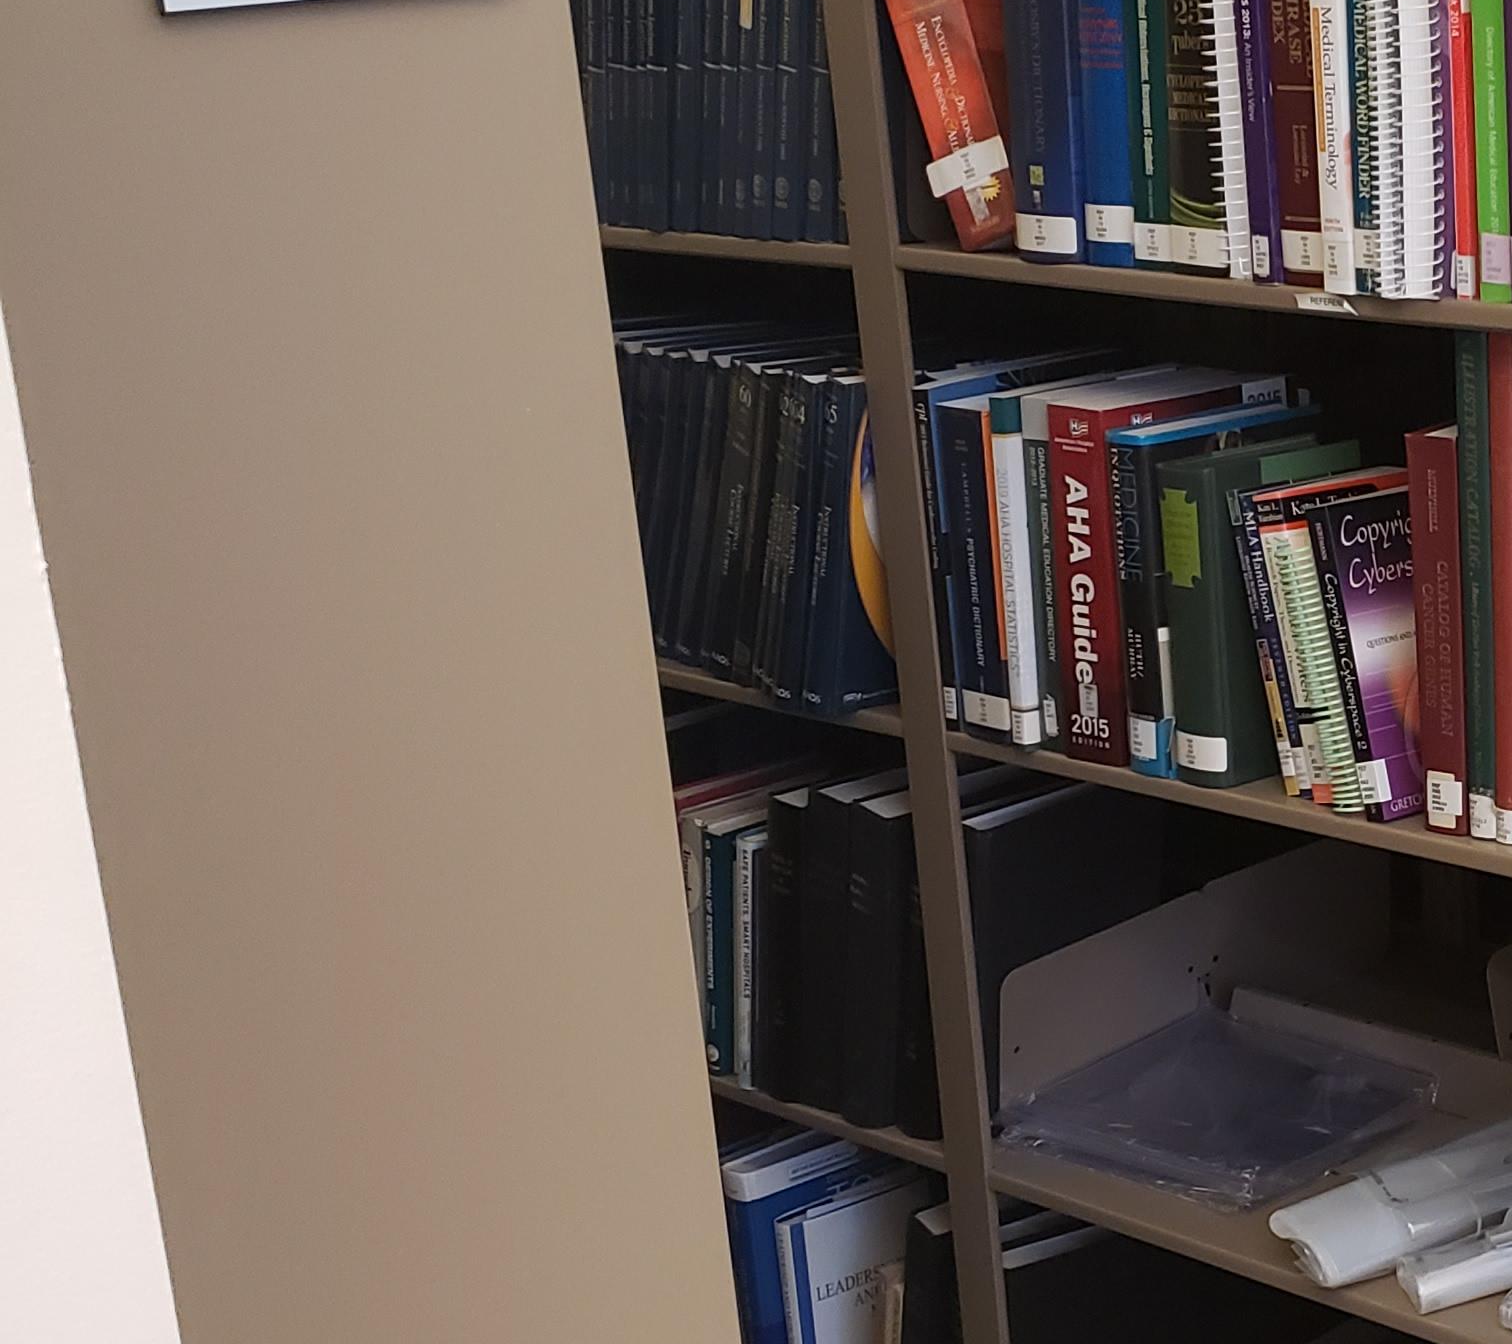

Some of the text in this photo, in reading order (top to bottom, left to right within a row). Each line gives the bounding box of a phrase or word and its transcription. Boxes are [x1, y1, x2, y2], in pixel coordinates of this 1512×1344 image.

[931, 15, 958, 84] ENCYCLOPEDIA
[1450, 10, 1460, 37] 2014
[1033, 55, 1046, 153] DICTIONARY
[1320, 7, 1339, 190] Medical Terminology
[1353, 0, 1371, 199] MEDICAL WORD FINDER
[1488, 130, 1498, 167] Medical
[1037, 447, 1056, 662] GRADUATE MEDICAL EDUCATION DIRECTORY
[1119, 448, 1143, 582] MEDICINE
[1243, 512, 1258, 546] MLA
[1251, 550, 1274, 622] Handbook
[1466, 488, 1482, 568] CATALOG
[966, 537, 985, 668] PSYCHIATRIC DICTIONARY
[999, 499, 1021, 672] AHA HOSPITAL STATISTICS
[1064, 474, 1098, 684] AHA Guide
[1350, 558, 1413, 595] Cybers
[1325, 573, 1368, 750] Copyright Cyberspace 2
[1421, 583, 1438, 708] CANCER GENES
[1437, 560, 1454, 737] CATALOG OF HUMAN
[1071, 714, 1110, 739] 2015
[1072, 737, 1110, 749] EDITION
[743, 921, 751, 950] SMART
[743, 953, 752, 999] HOSPITALS
